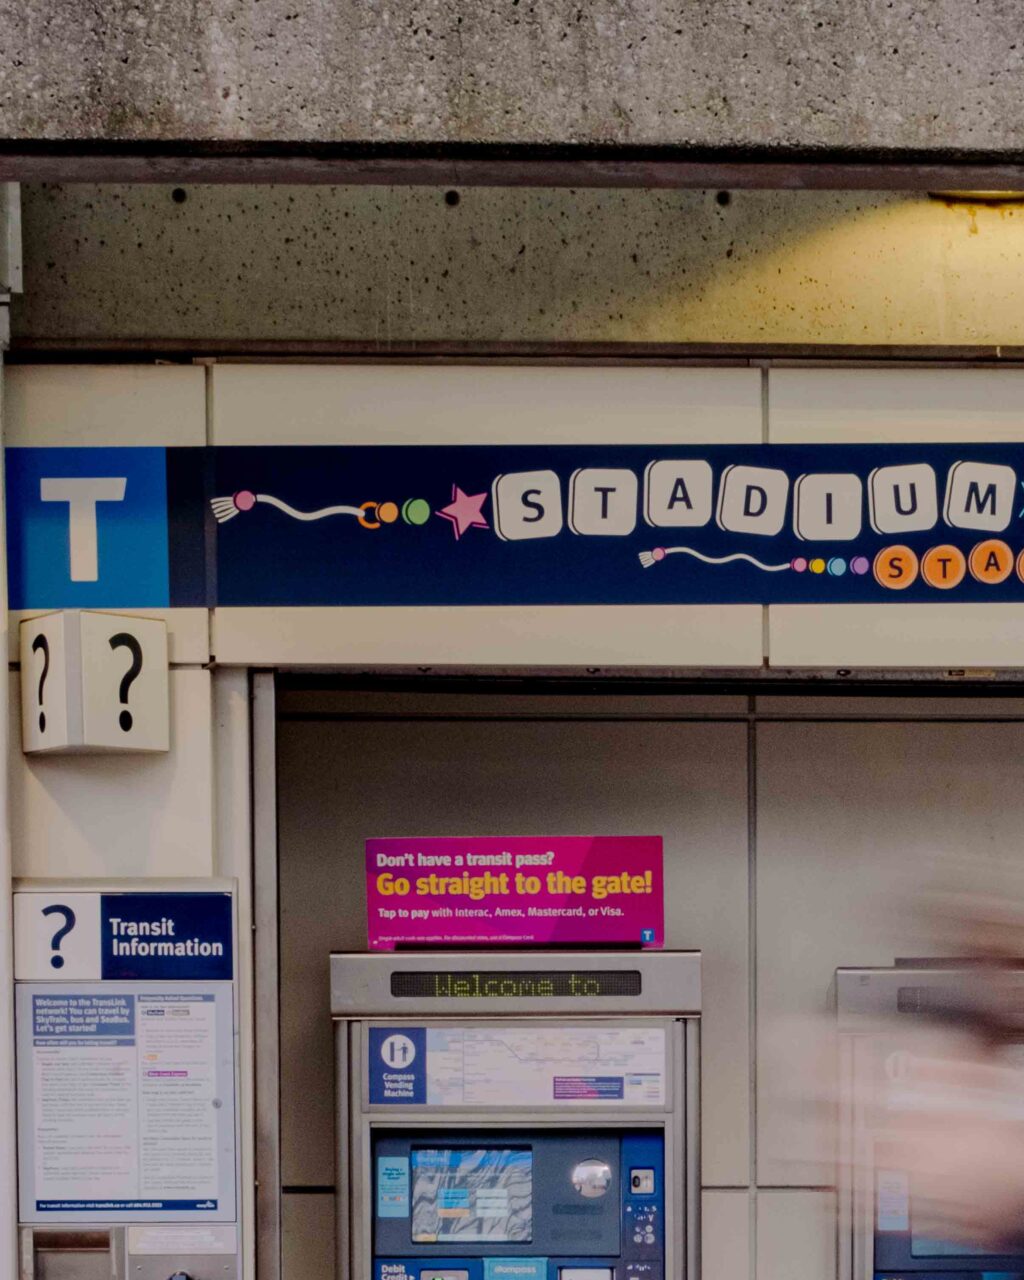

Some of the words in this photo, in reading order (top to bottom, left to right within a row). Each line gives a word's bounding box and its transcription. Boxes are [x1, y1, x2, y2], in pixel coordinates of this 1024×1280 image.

[522, 477, 998, 526] STADIUM
[376, 853, 415, 867] Don't
[417, 852, 451, 866] have
[454, 855, 463, 866] a
[466, 851, 512, 866] transit
[515, 851, 555, 868] pass?
[376, 872, 411, 896] Go
[416, 870, 510, 900] straight
[515, 872, 541, 895] to
[546, 870, 587, 895] the
[591, 870, 652, 900] gate!
[378, 908, 396, 919] Tap
[398, 908, 409, 917] to
[411, 909, 429, 920] pay
[431, 908, 453, 917] with
[455, 908, 493, 918] Interac,
[494, 907, 526, 918] Amex,
[527, 906, 586, 917] Mastercard,
[588, 908, 599, 916] or
[600, 907, 625, 916] Visa.
[109, 917, 175, 936] Transit
[112, 937, 223, 957] Information
[435, 973, 554, 997] Welcome
[568, 973, 600, 996] to
[35, 998, 68, 1007] Welcome
[382, 1072, 416, 1082] Compass
[383, 1081, 414, 1090] Vending
[383, 1090, 415, 1098] Machine
[381, 1264, 406, 1273] Debit
